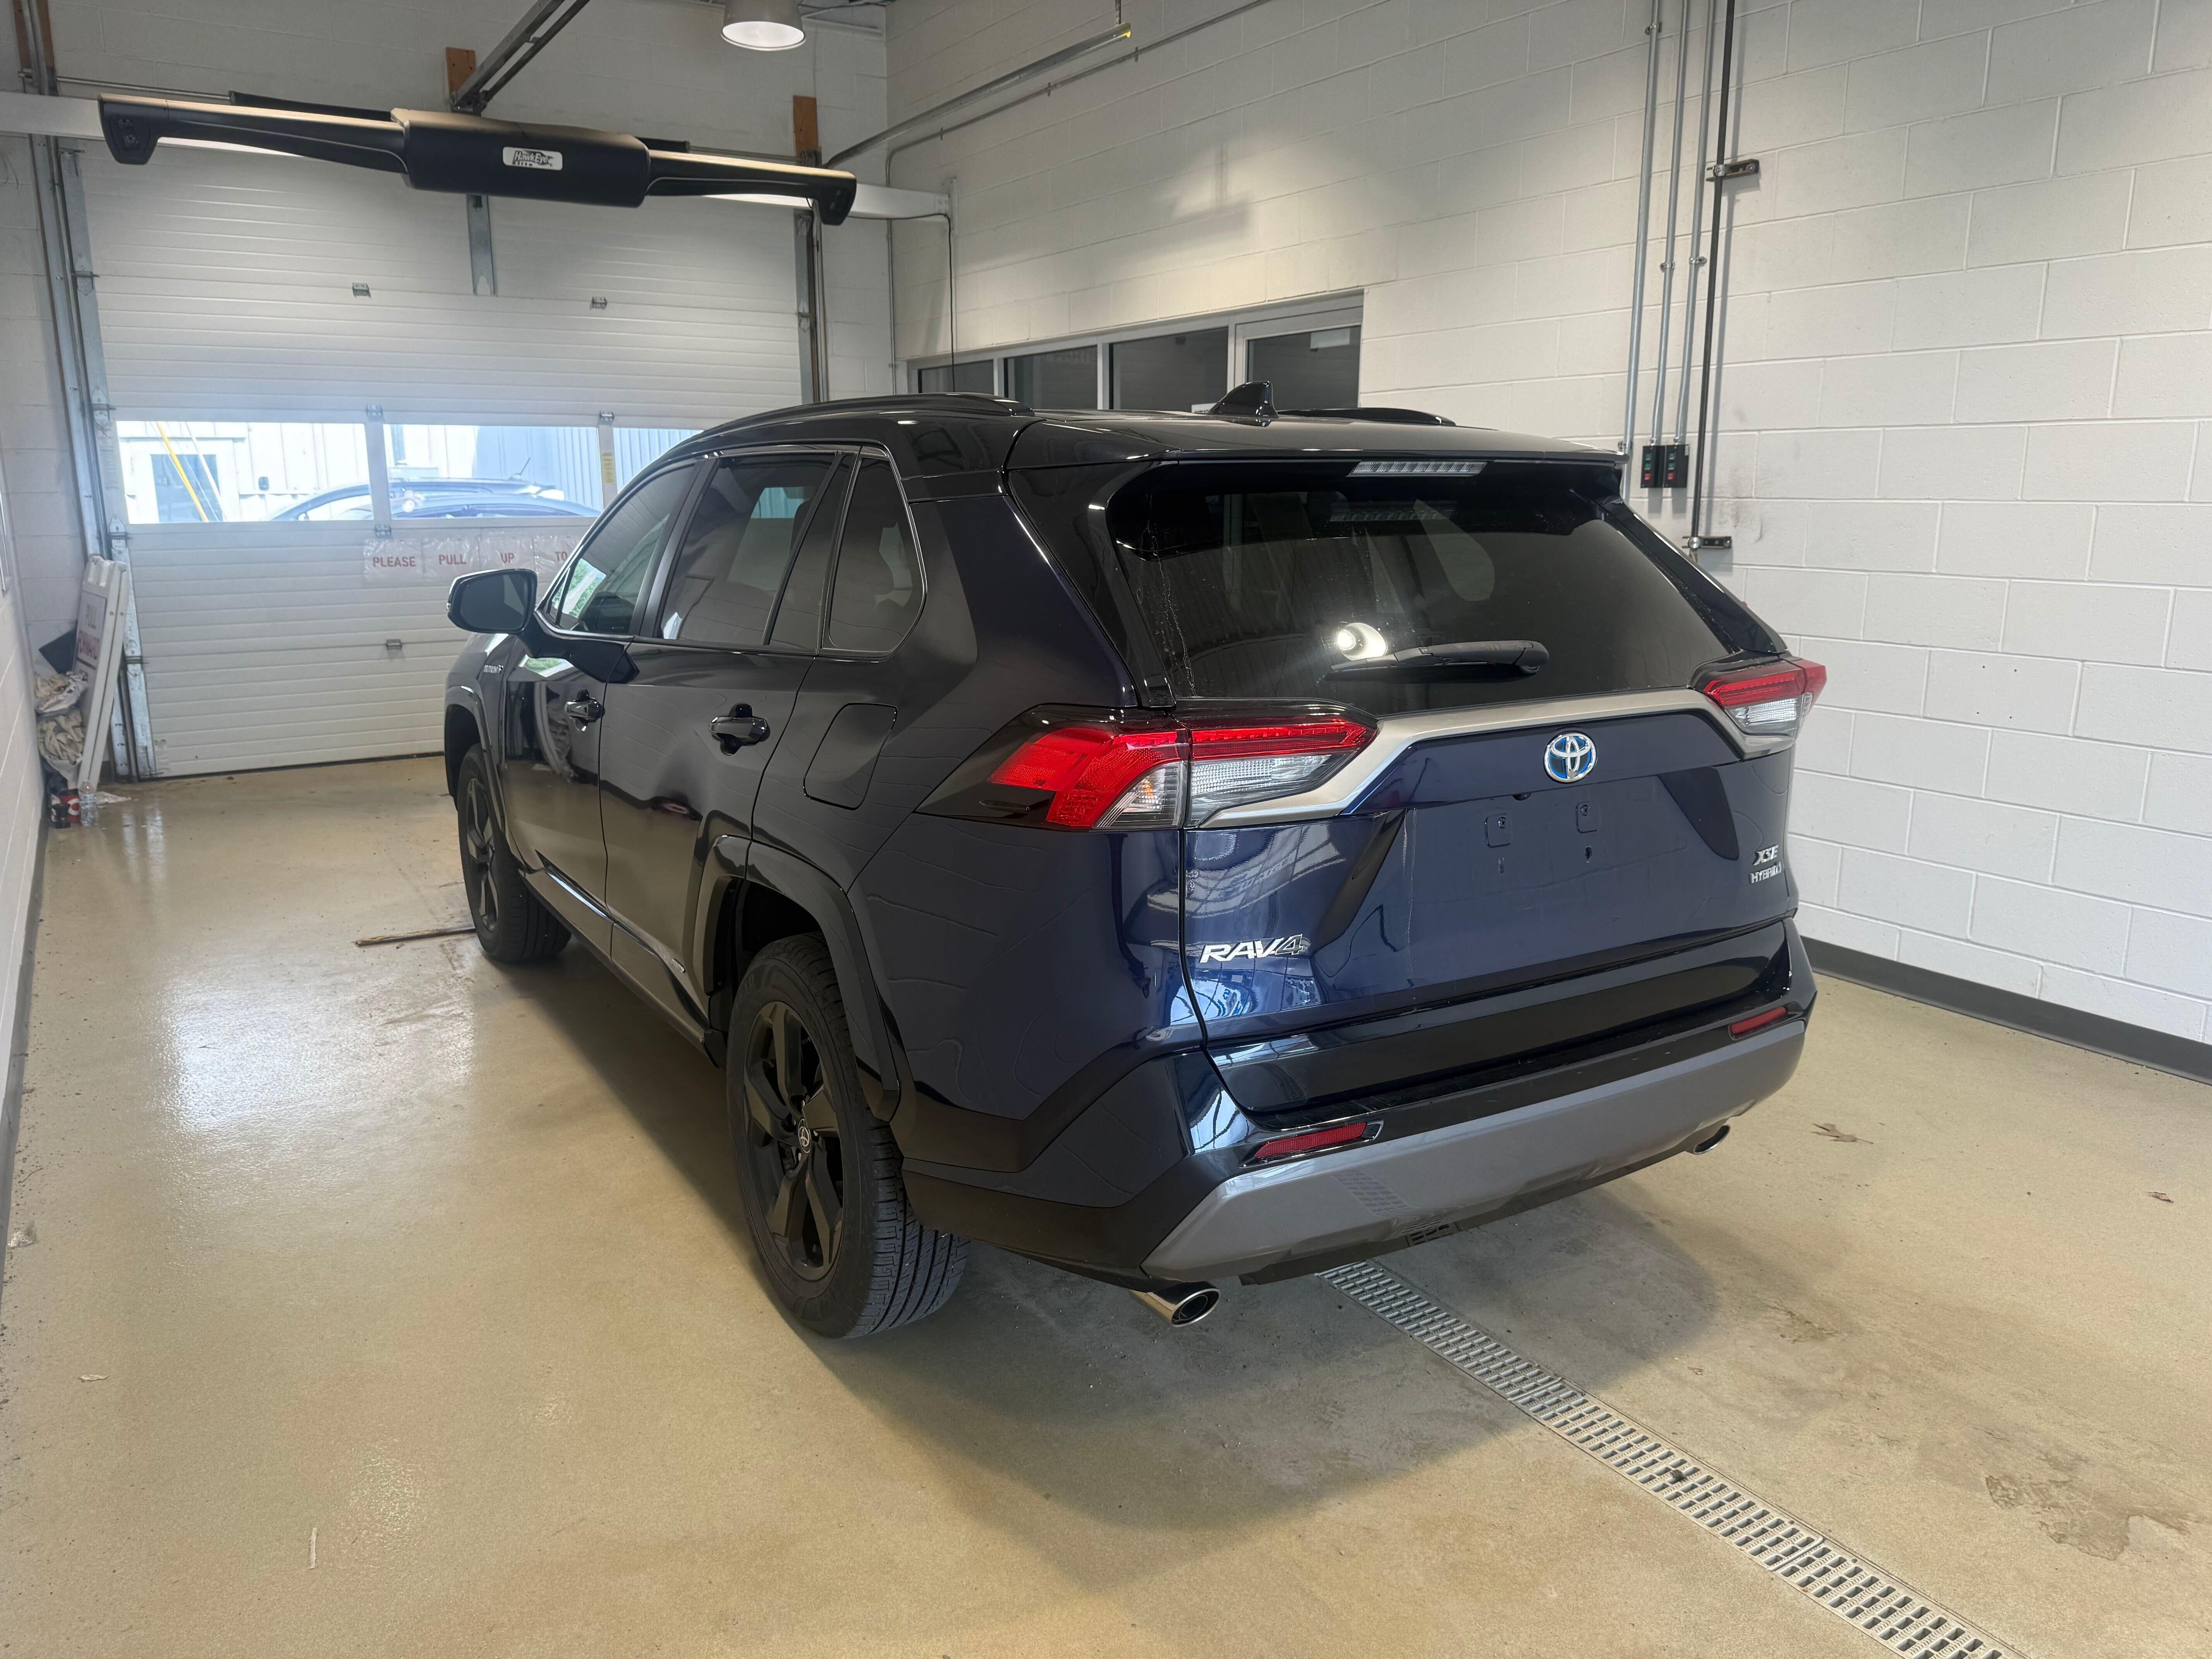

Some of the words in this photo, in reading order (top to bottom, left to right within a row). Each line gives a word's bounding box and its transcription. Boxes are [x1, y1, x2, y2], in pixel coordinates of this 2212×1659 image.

[372, 556, 416, 567] PLEASE
[438, 554, 467, 565] PULL
[500, 552, 515, 564] UP
[555, 551, 567, 561] TO
[1753, 844, 1779, 866] XSE
[1750, 861, 1782, 883] HYBRID
[1199, 933, 1304, 963] RAV4
